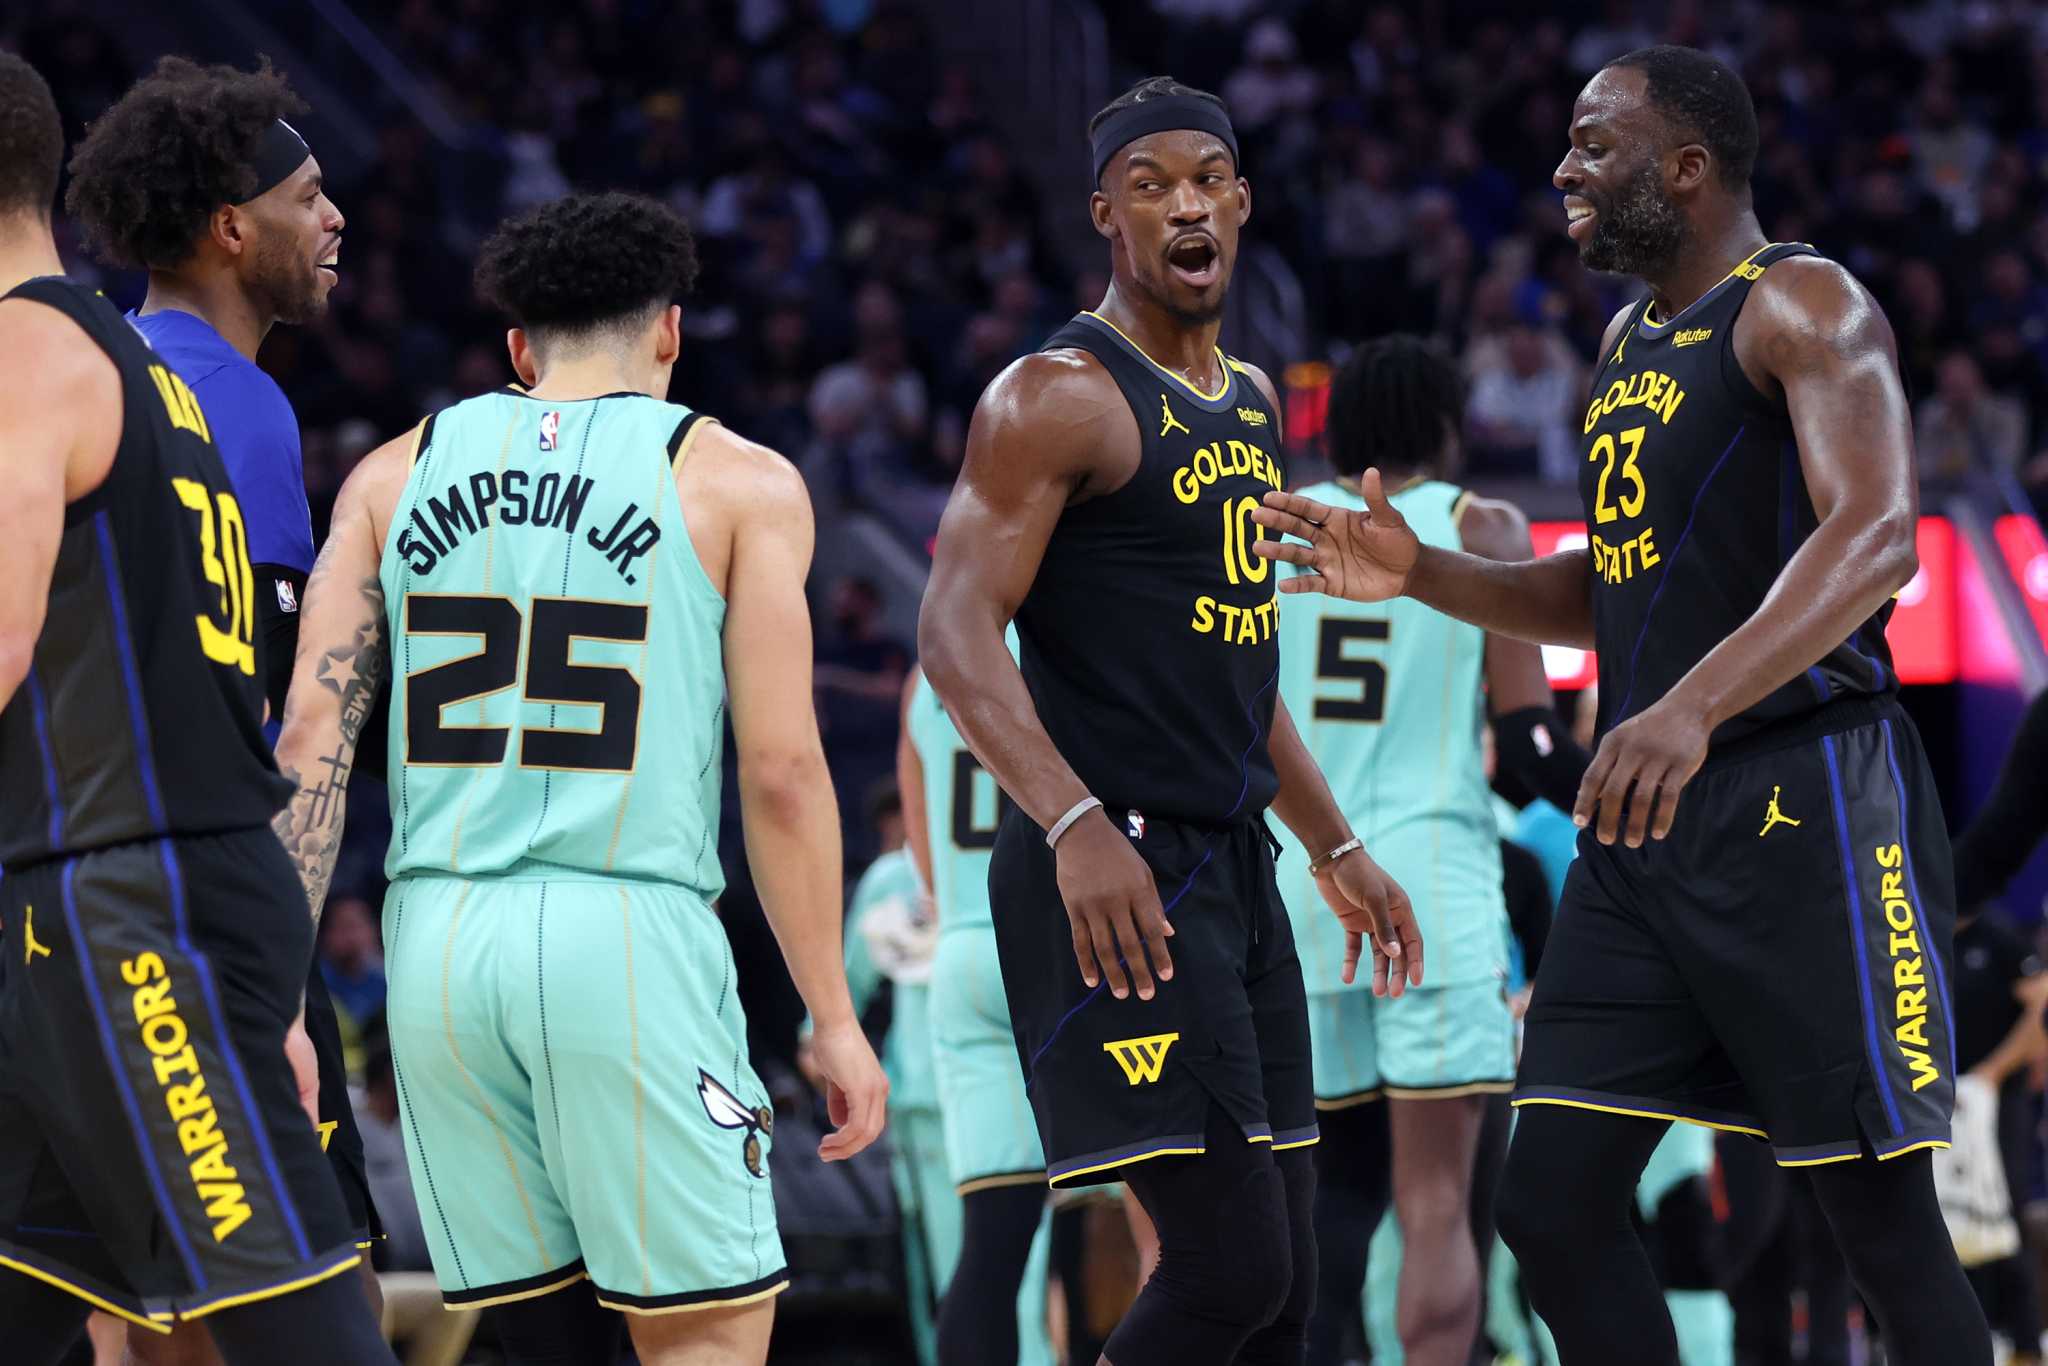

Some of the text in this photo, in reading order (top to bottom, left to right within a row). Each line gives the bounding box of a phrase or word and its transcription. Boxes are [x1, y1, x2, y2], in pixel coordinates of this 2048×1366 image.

[1672, 328, 1712, 348] Rakuten
[1584, 371, 1684, 434] GOLDEN
[1173, 440, 1281, 504] GOLDEN
[1589, 426, 1646, 524] 23
[171, 477, 255, 676] 30
[397, 470, 661, 585] SIMPSON JR.
[1223, 496, 1268, 584] 10
[1592, 527, 1660, 584] STATE
[403, 592, 652, 775] 25
[1313, 615, 1391, 723] 5
[1876, 843, 1939, 1092] WARRIORS
[121, 951, 252, 1244] WARRIORS
[1104, 1032, 1179, 1086] W
